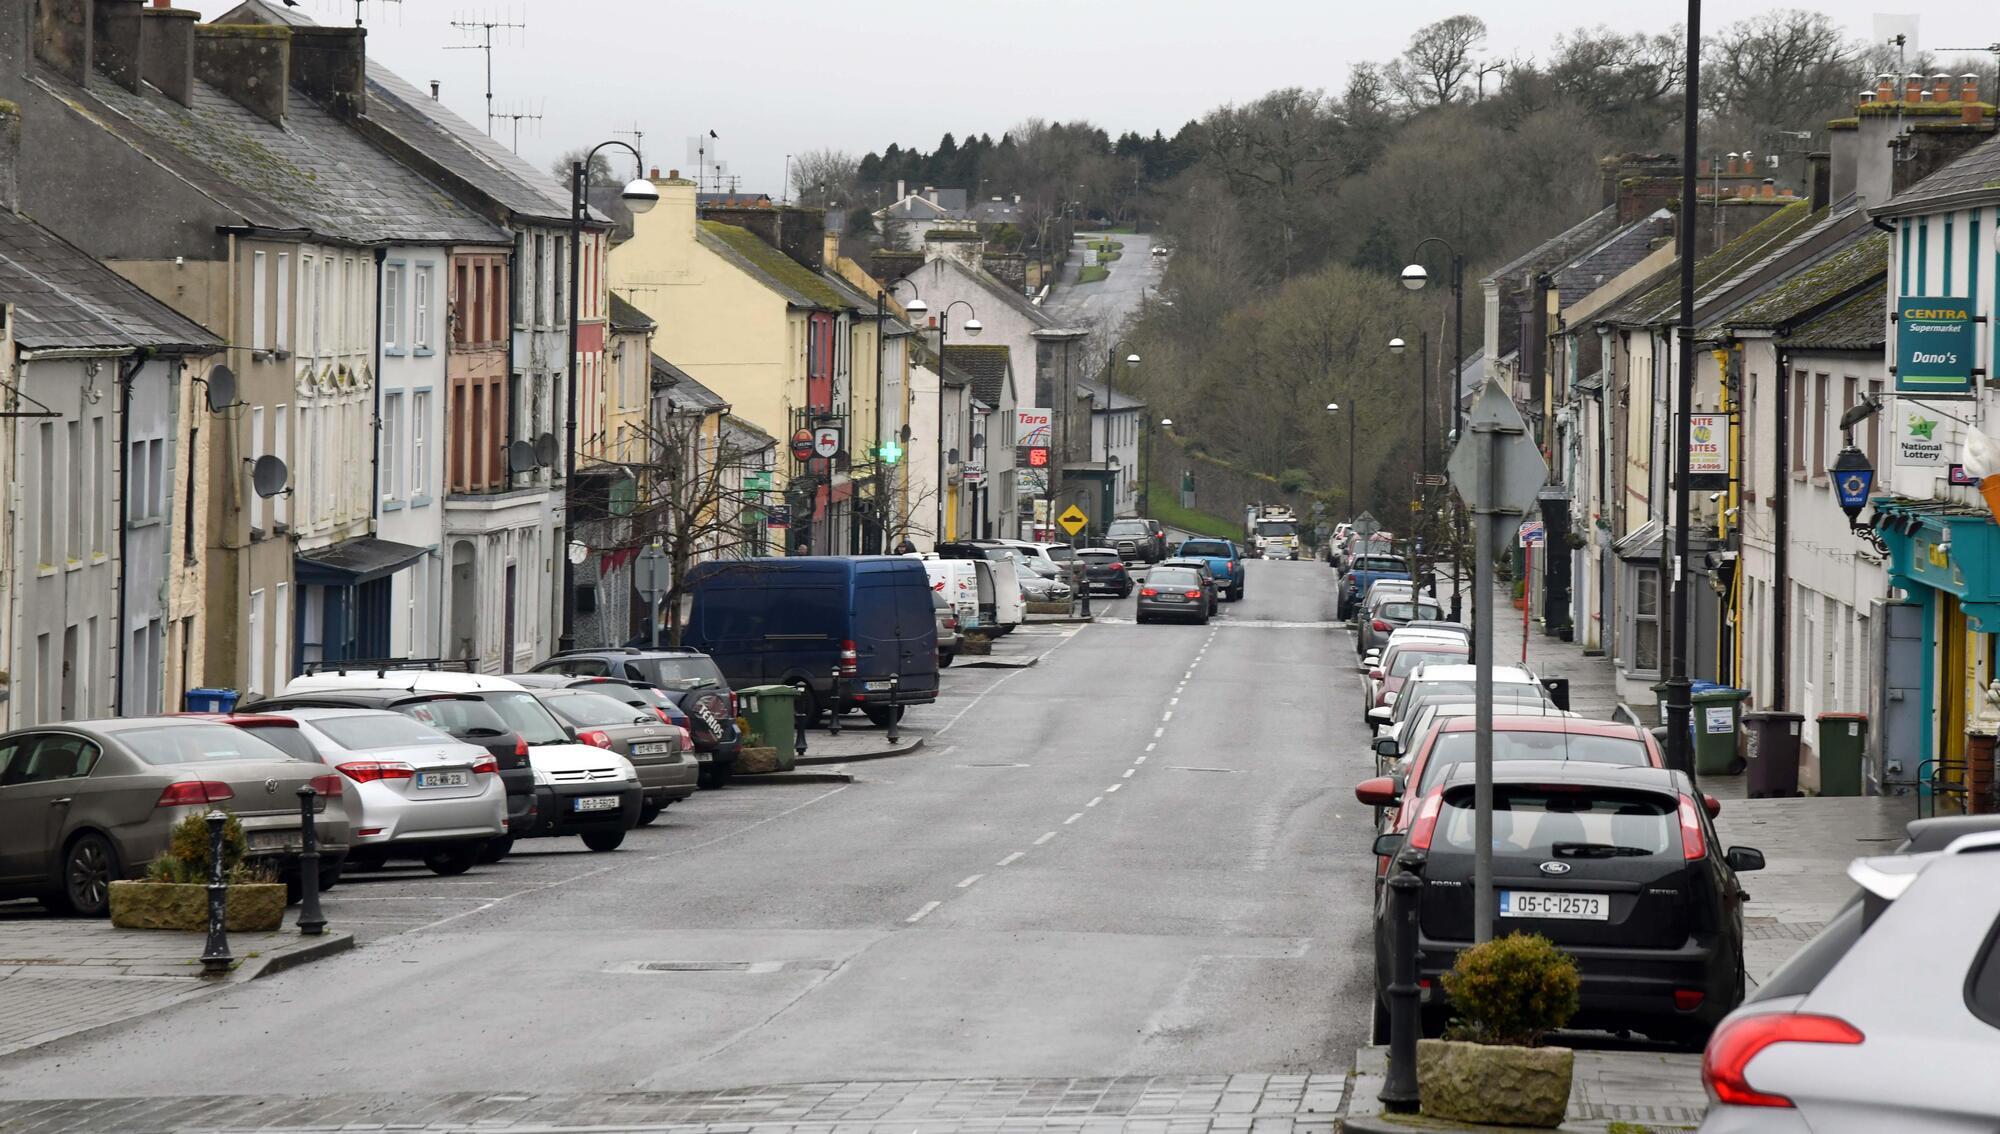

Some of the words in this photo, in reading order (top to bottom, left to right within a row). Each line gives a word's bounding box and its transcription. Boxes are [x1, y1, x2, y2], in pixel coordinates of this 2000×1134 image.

[1904, 308, 1968, 320] CENTRA
[1909, 323, 1962, 333] Supermarket
[1912, 352, 1957, 364] Dano's
[1018, 413, 1048, 424] Tara
[1901, 441, 1942, 451] National
[1903, 451, 1940, 461] Lottery
[699, 703, 725, 739] TERIOS
[1518, 896, 1599, 914] 05-C-12573
